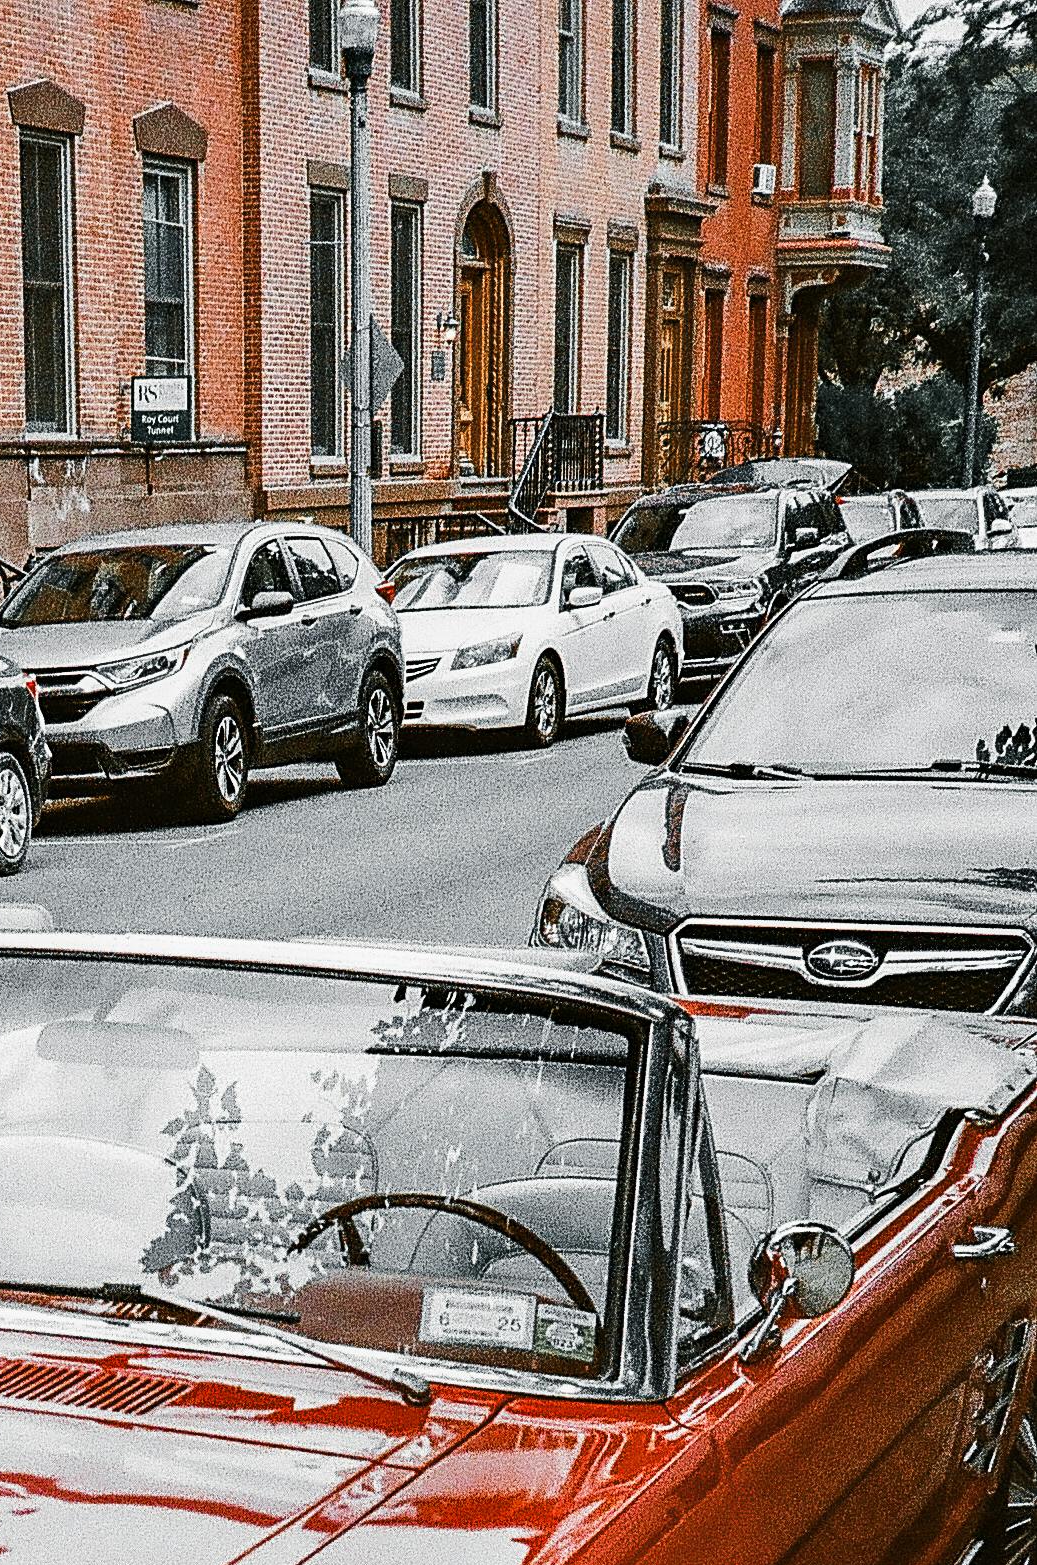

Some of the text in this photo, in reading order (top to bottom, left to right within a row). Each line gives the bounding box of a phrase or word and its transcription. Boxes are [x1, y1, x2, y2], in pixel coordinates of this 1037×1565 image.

[158, 414, 179, 423] Court
[147, 426, 174, 435] Tunnel
[498, 1315, 521, 1333] 25
